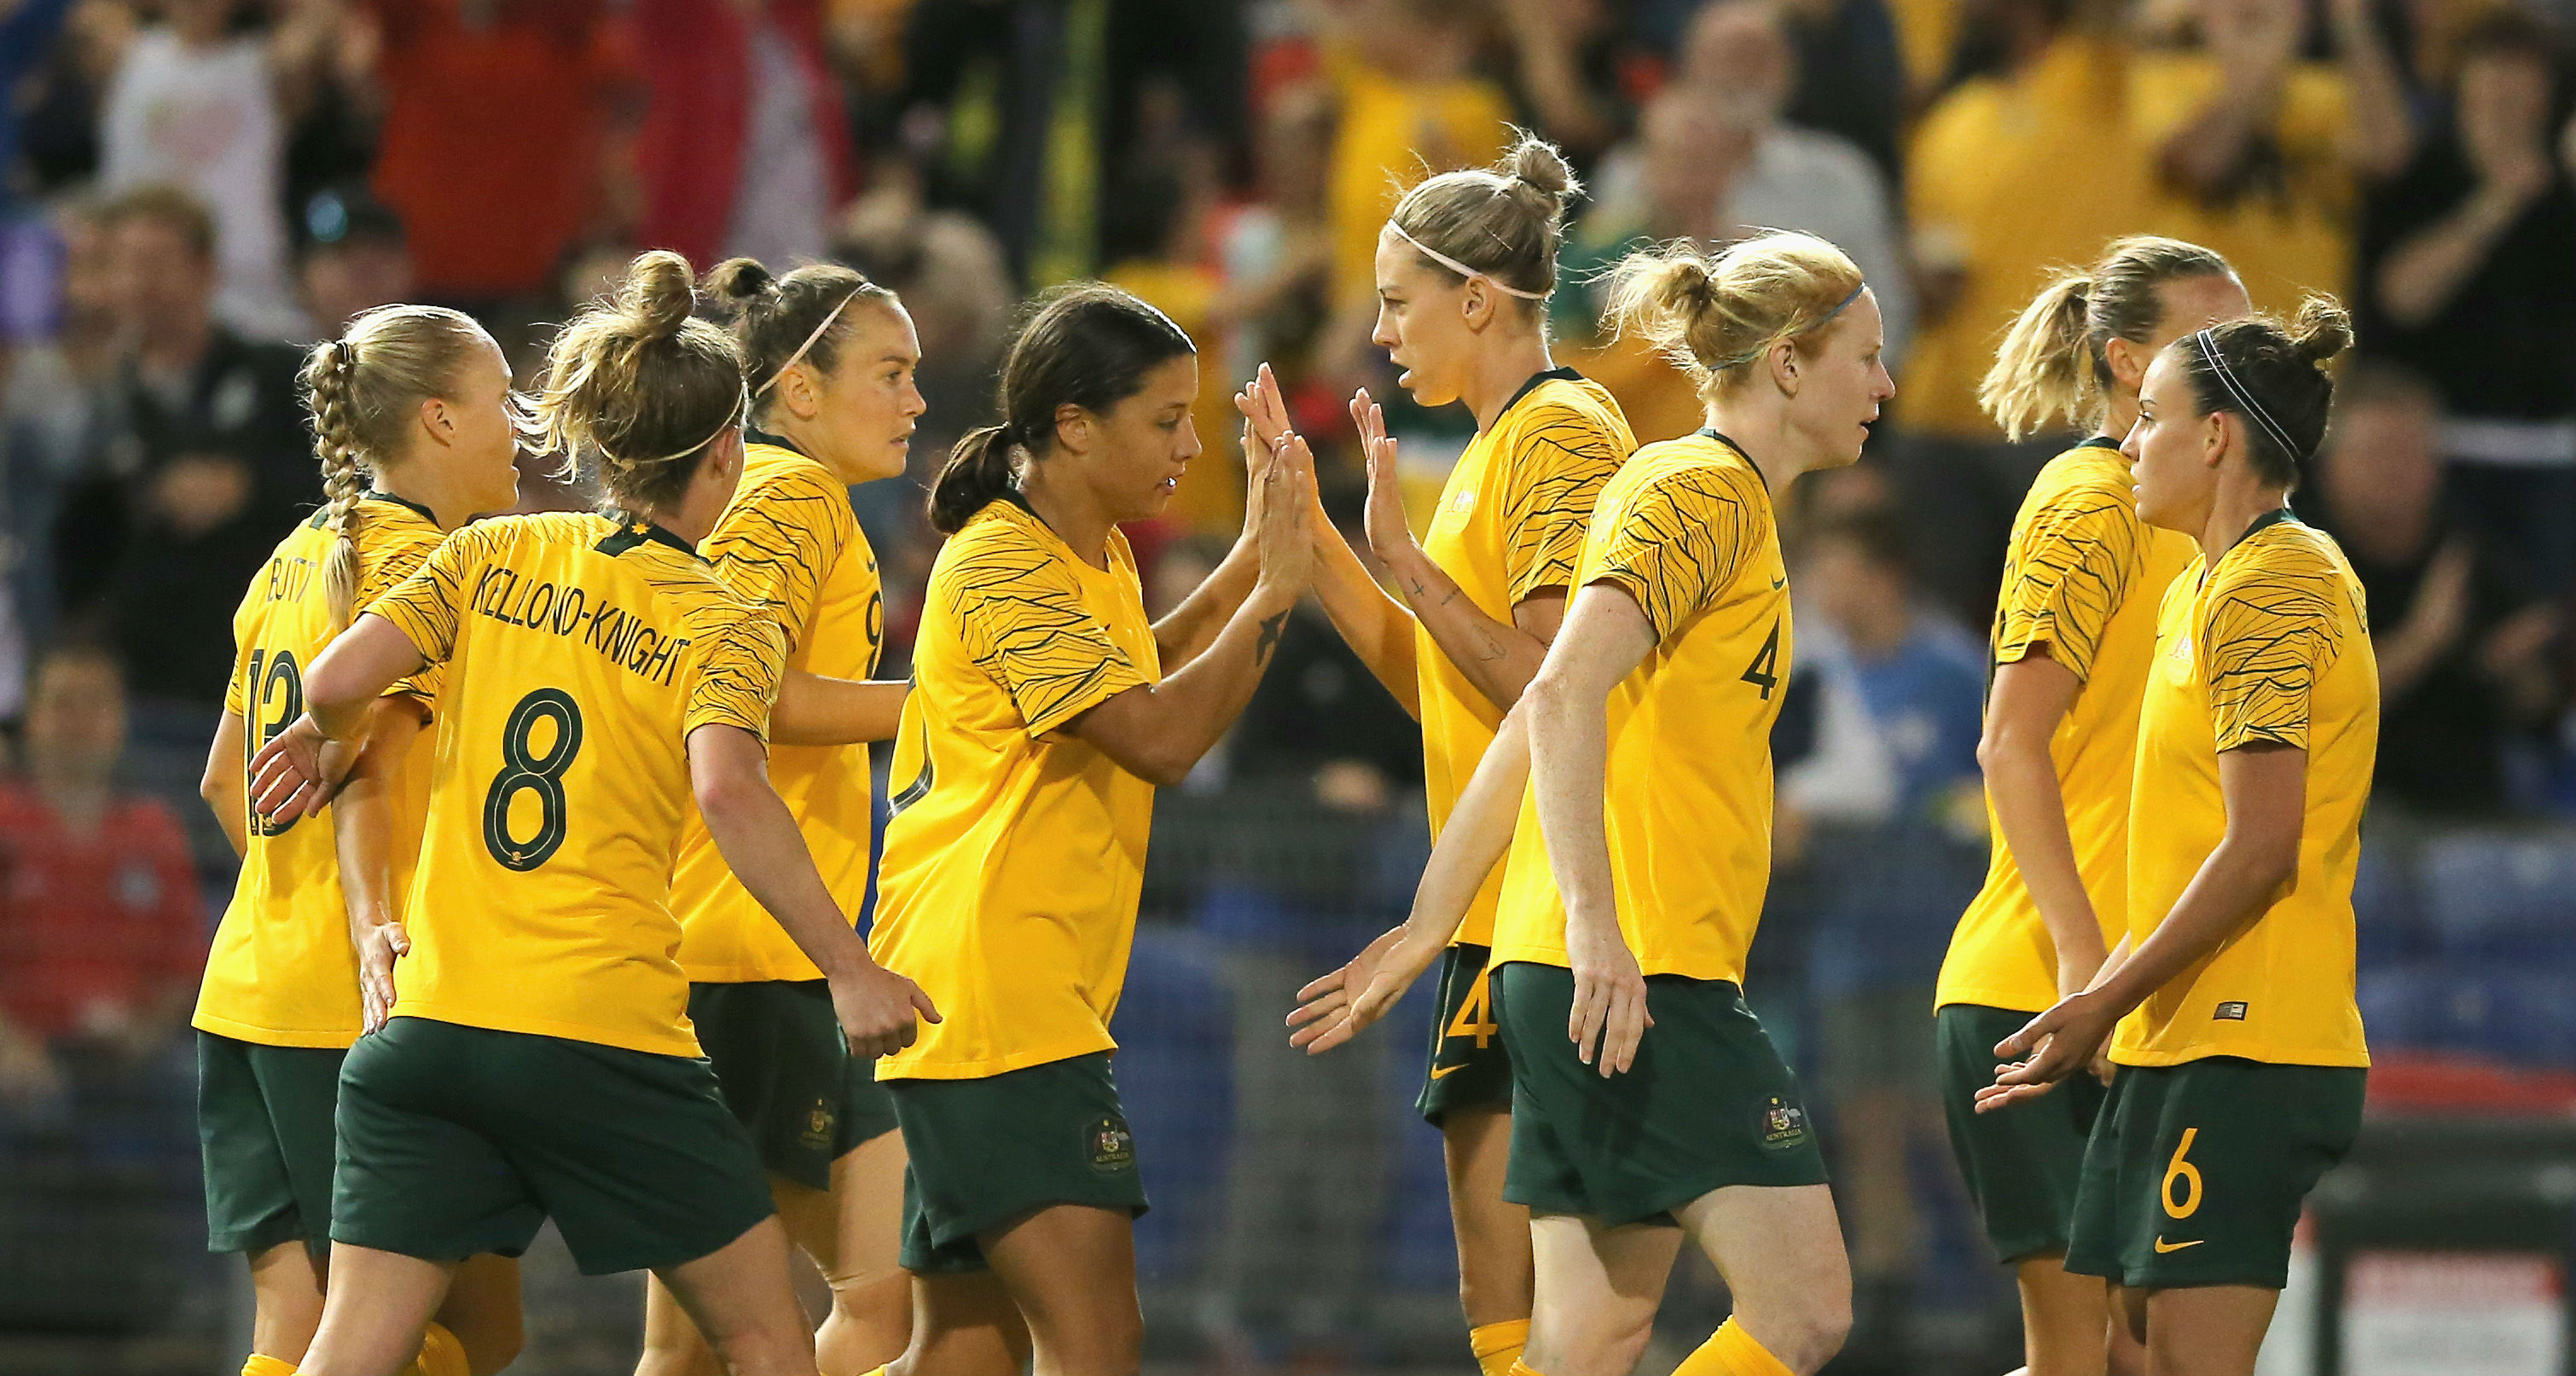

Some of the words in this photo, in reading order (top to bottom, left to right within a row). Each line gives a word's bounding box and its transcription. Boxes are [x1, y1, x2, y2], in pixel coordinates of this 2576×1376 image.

[470, 563, 692, 687] KELLOND-KNIGHT
[1739, 611, 1779, 700] 4
[483, 688, 583, 872] 8
[2161, 1127, 2203, 1219] 6
